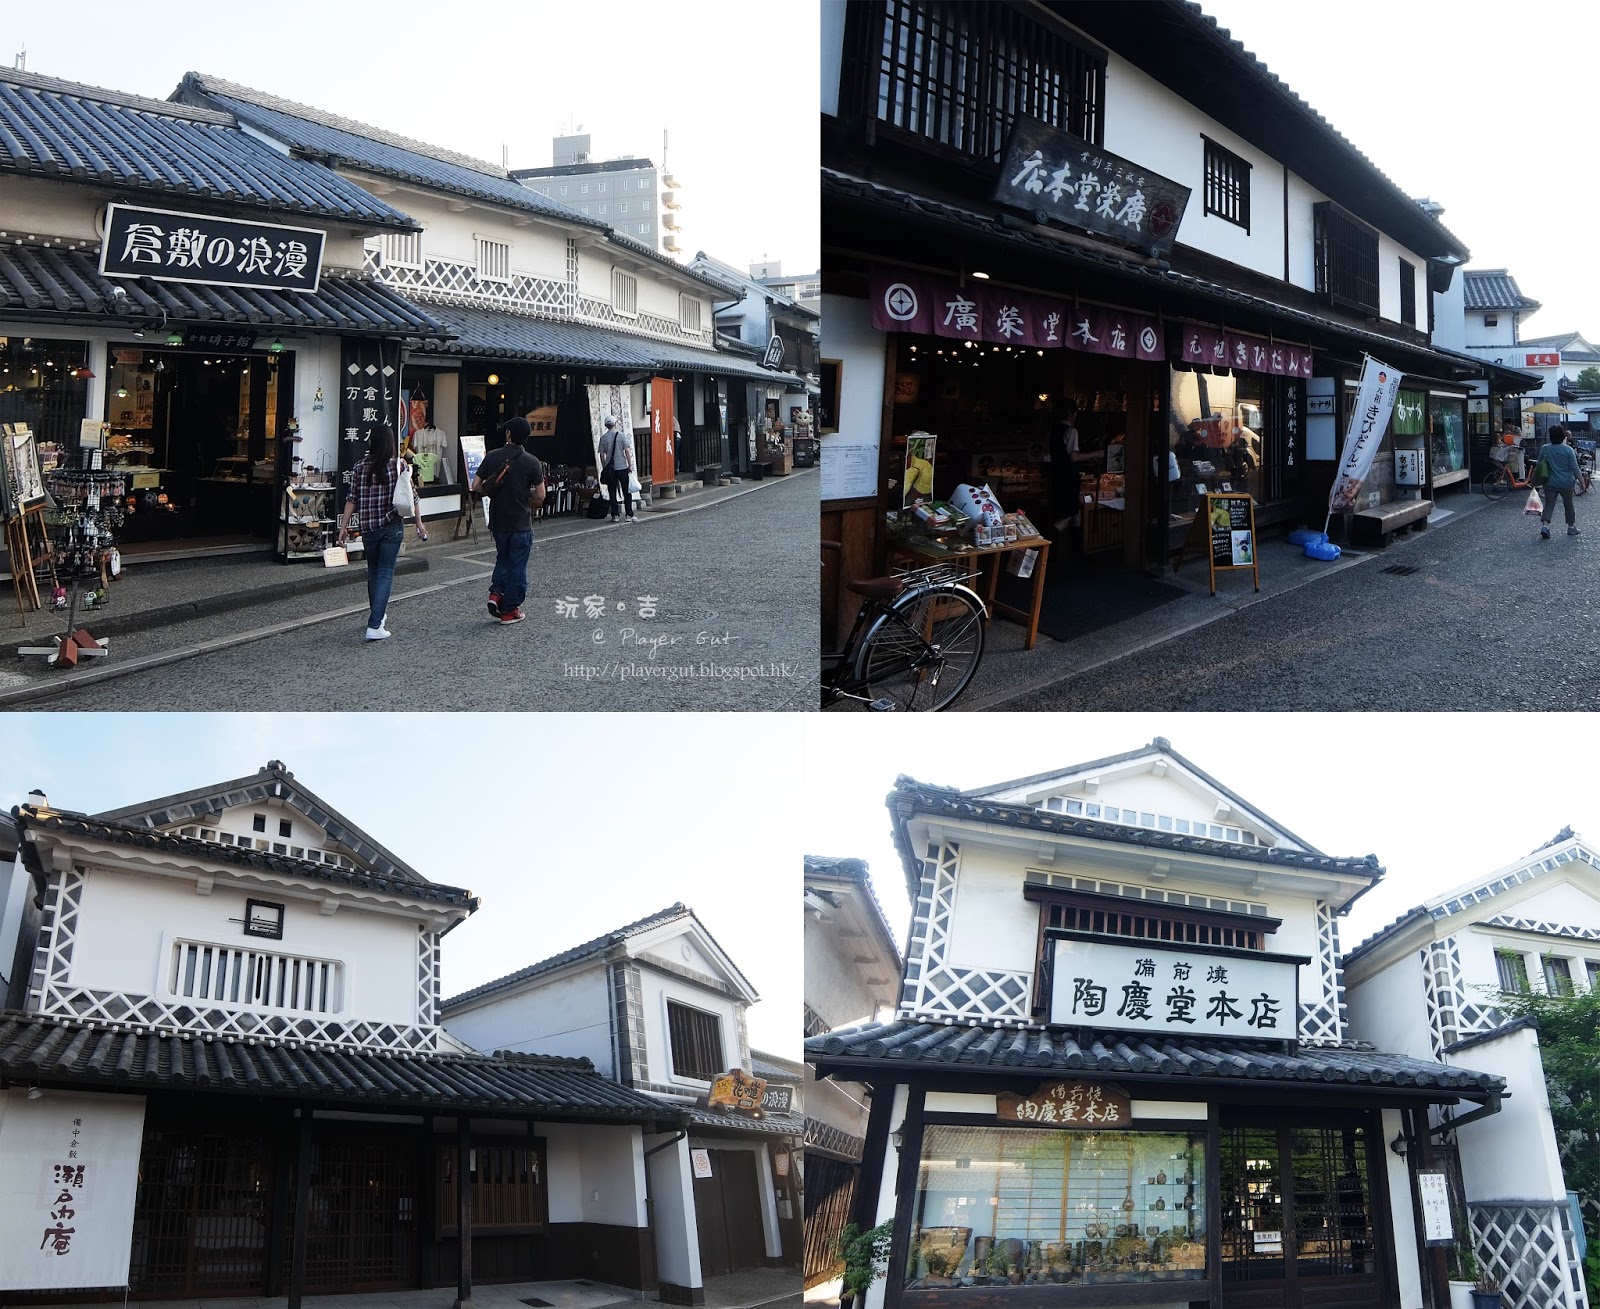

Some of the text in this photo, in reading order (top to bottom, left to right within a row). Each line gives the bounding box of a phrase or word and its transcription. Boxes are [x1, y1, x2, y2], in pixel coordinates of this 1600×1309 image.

[119, 222, 309, 280] 倉敷の浪漫
[943, 294, 1126, 351] 廣榮堂本店
[1071, 977, 1283, 1030] 陶慶堂本店
[67, 1117, 83, 1159] 備中倉敷
[1016, 1100, 1120, 1123] 陶慶堂本店
